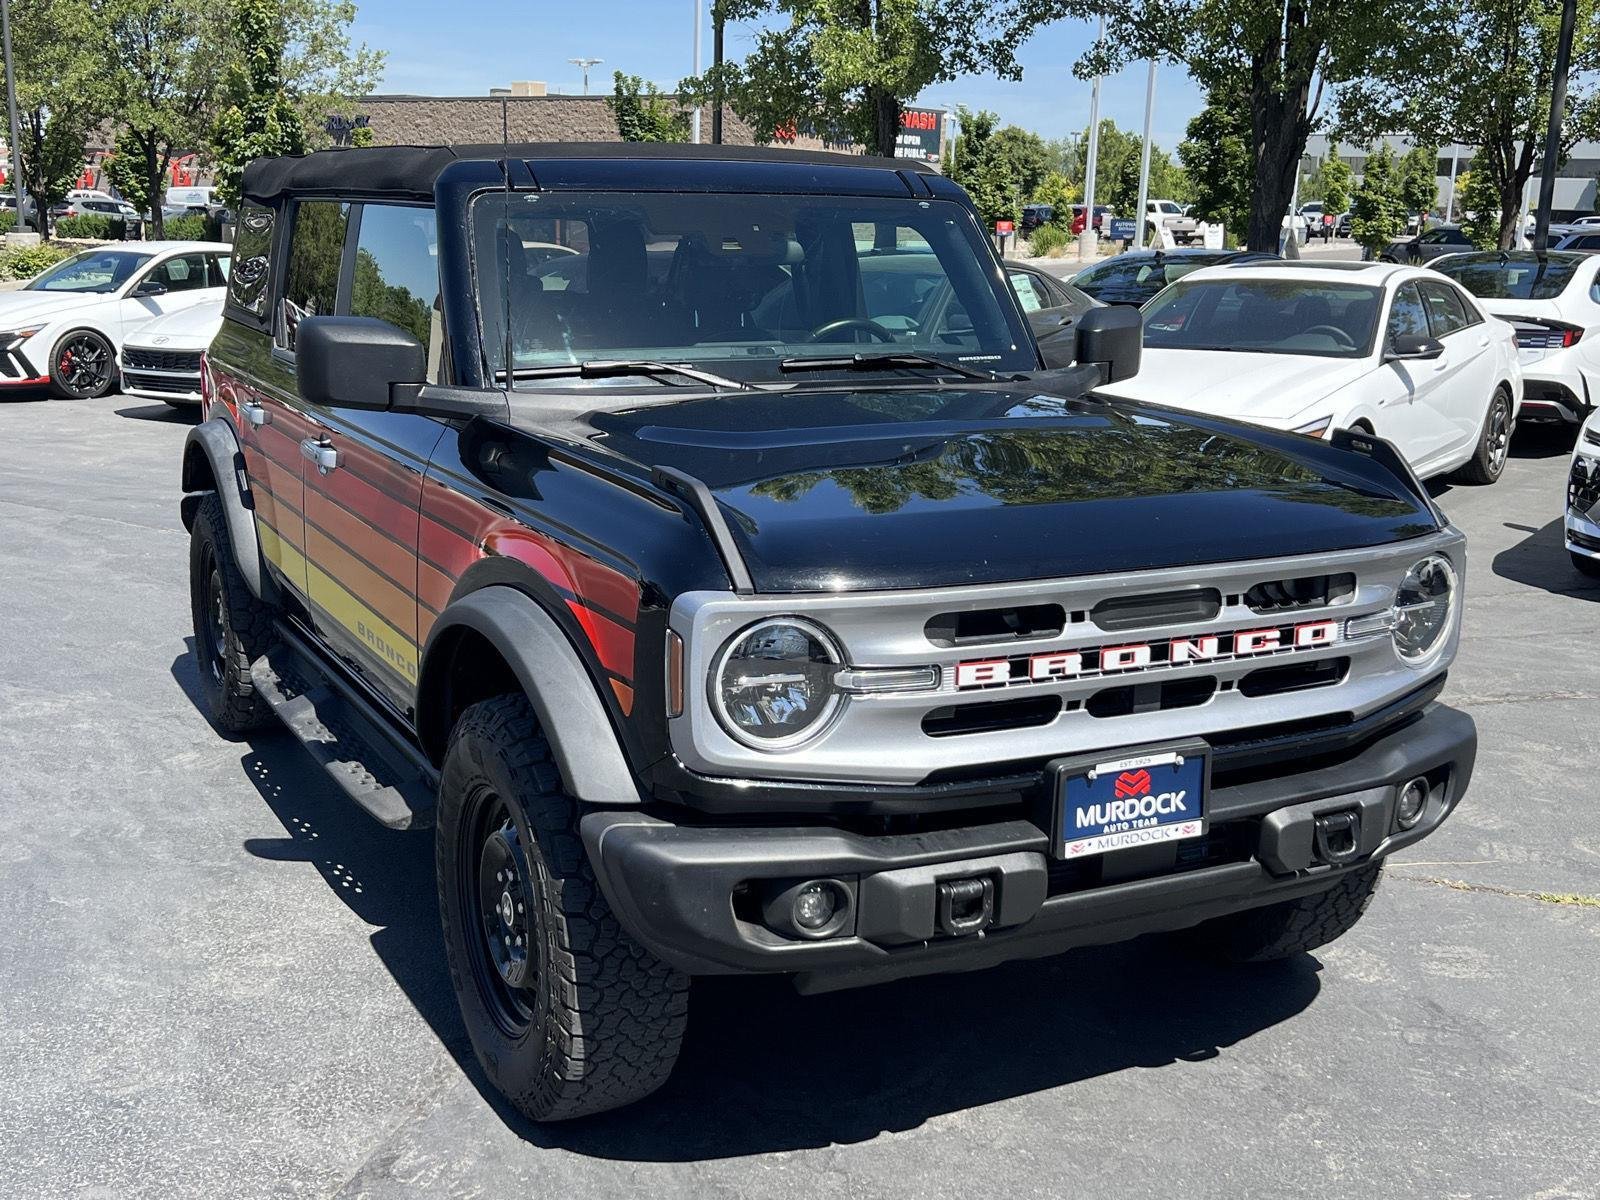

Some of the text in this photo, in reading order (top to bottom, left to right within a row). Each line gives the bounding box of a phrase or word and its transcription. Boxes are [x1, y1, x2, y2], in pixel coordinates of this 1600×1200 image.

[904, 135, 921, 145] OPEN
[904, 147, 927, 159] PUBLIC
[357, 621, 417, 678] BRONCO
[954, 619, 1339, 688] BRONCO
[1076, 790, 1187, 829] MURDOCK
[1103, 817, 1158, 834] AUTO TEAM
[1097, 827, 1171, 850] MURDOCK
